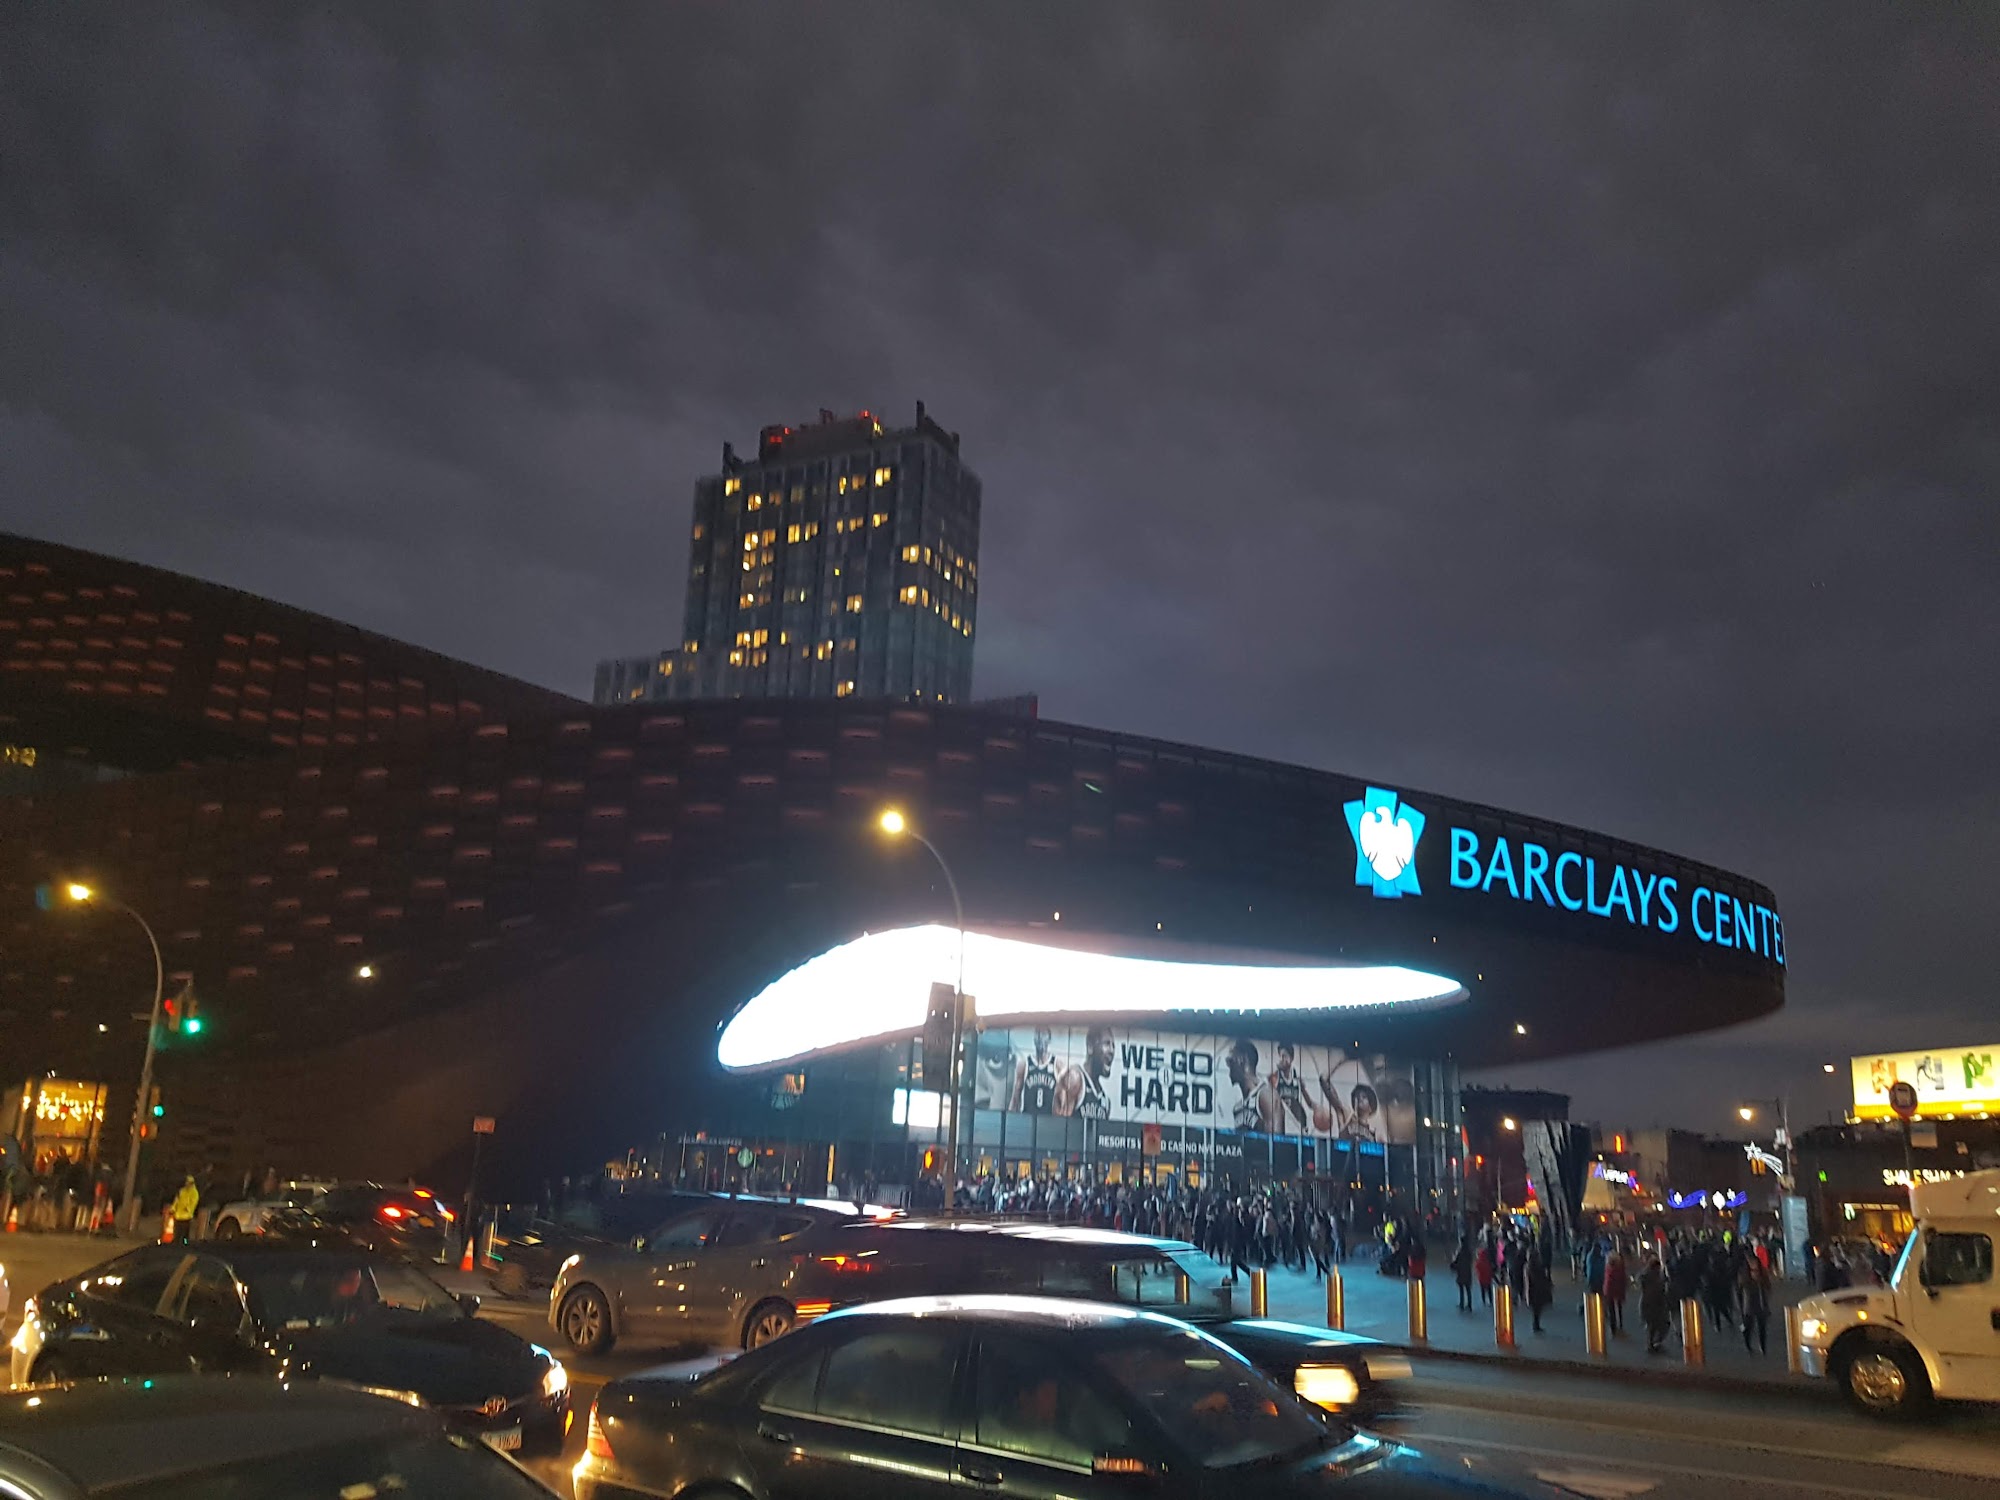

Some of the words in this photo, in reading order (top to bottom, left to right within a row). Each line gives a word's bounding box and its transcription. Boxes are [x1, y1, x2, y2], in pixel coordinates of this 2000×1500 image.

[1449, 827, 1679, 933] BARCLAYS
[1691, 887, 1788, 971] CENTE
[1121, 1043, 1164, 1071] WE
[1170, 1050, 1213, 1077] GO
[1121, 1075, 1213, 1114] HARD
[1099, 1135, 1136, 1149] RESORTS
[1168, 1140, 1197, 1154] CASNO
[1216, 1143, 1243, 1157] PLAZA
